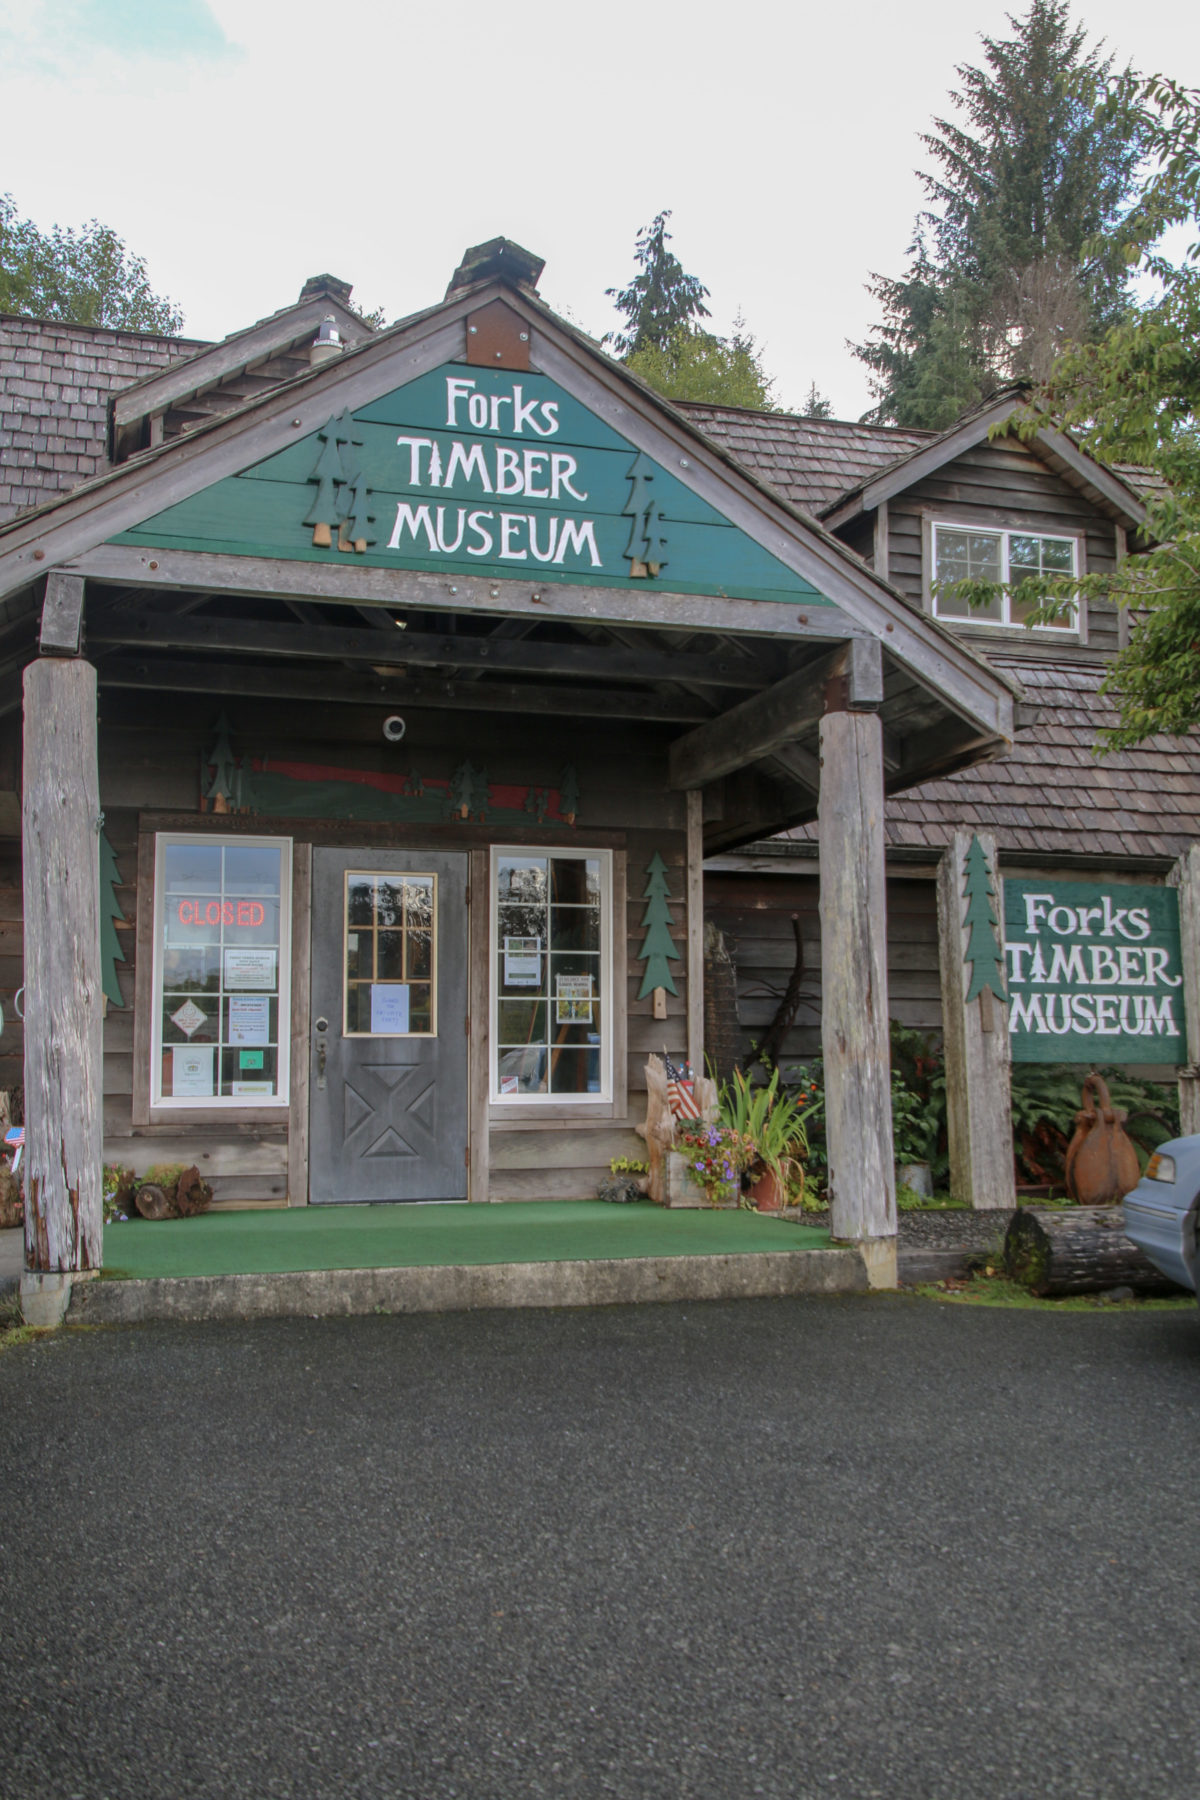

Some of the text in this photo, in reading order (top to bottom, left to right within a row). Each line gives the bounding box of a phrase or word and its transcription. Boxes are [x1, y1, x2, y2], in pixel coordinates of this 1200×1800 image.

[446, 377, 559, 436] Forks
[397, 436, 588, 502] TIMBER
[386, 502, 603, 567] MUSEUM
[178, 900, 264, 926] CLOSED
[1022, 894, 1151, 940] Forks
[1005, 938, 1182, 987] TIMBER
[1008, 992, 1180, 1036] MUSEUM
